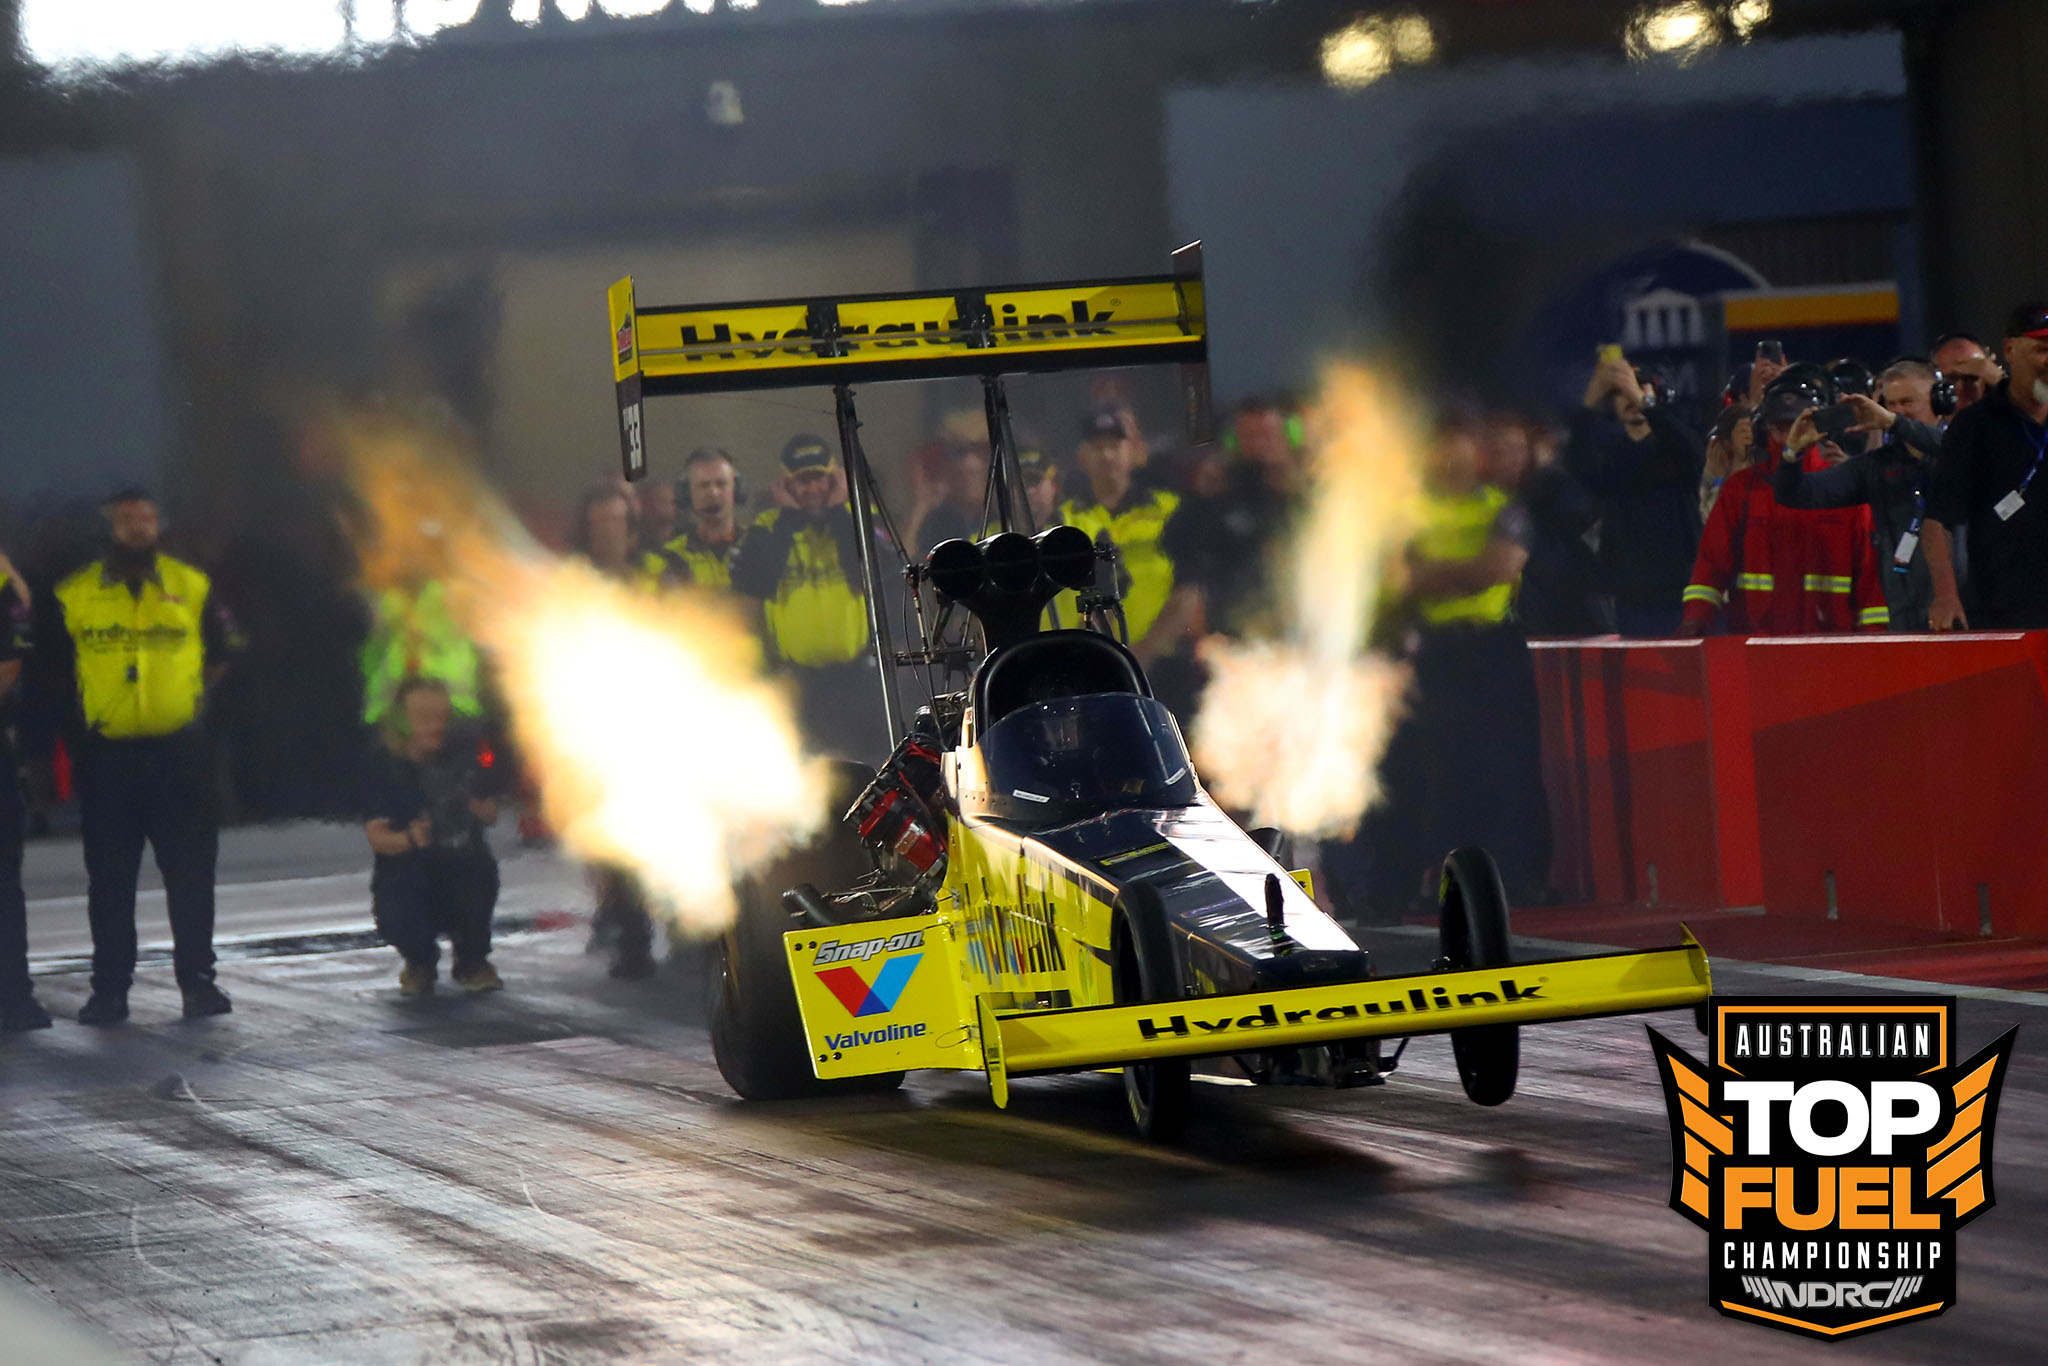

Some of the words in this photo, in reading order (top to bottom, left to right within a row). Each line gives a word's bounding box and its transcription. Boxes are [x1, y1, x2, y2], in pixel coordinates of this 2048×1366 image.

[813, 930, 925, 965] Snap-on
[1138, 979, 1549, 1041] Hydraulink
[824, 1022, 927, 1050] Valvoline
